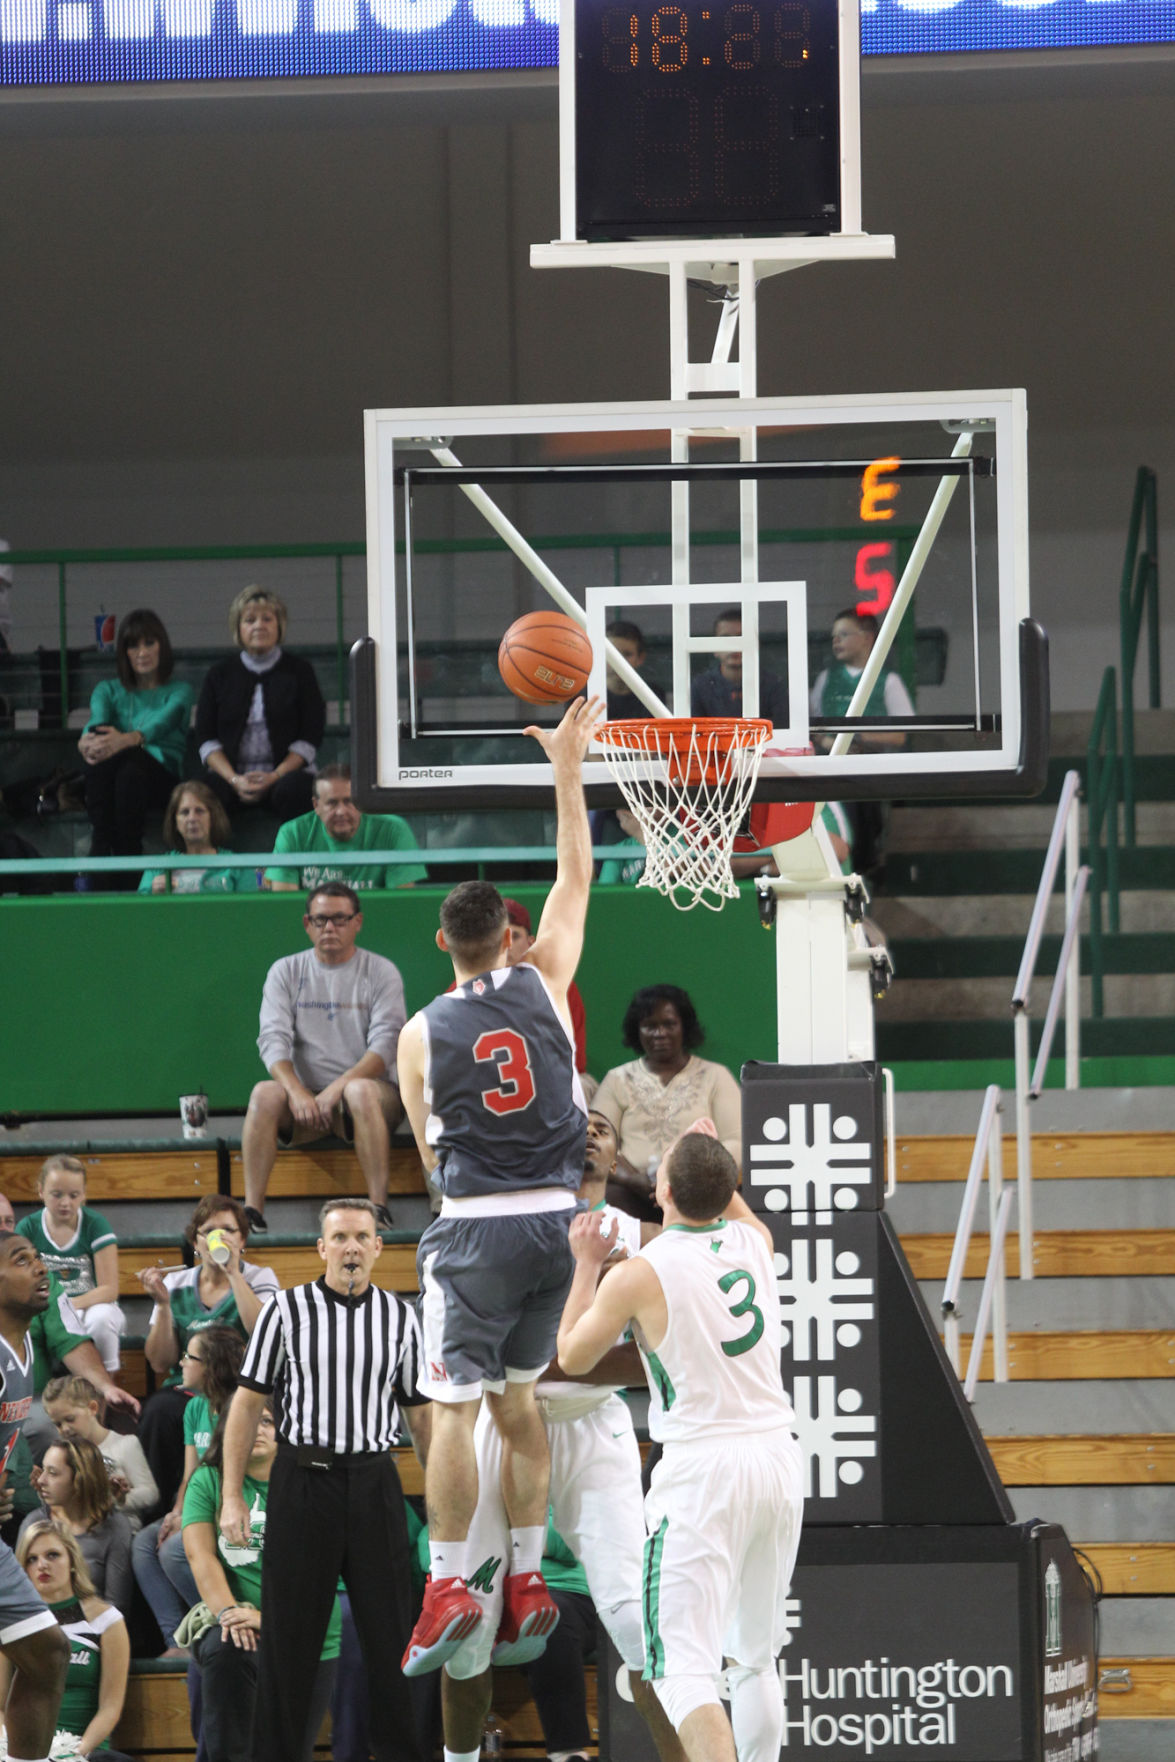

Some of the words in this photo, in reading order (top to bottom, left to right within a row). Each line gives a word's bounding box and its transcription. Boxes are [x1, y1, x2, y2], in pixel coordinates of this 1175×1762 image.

[472, 1027, 537, 1117] 3
[717, 1269, 765, 1358] 3
[778, 1656, 1014, 1709] Huntington
[781, 1703, 957, 1755] Hospital
